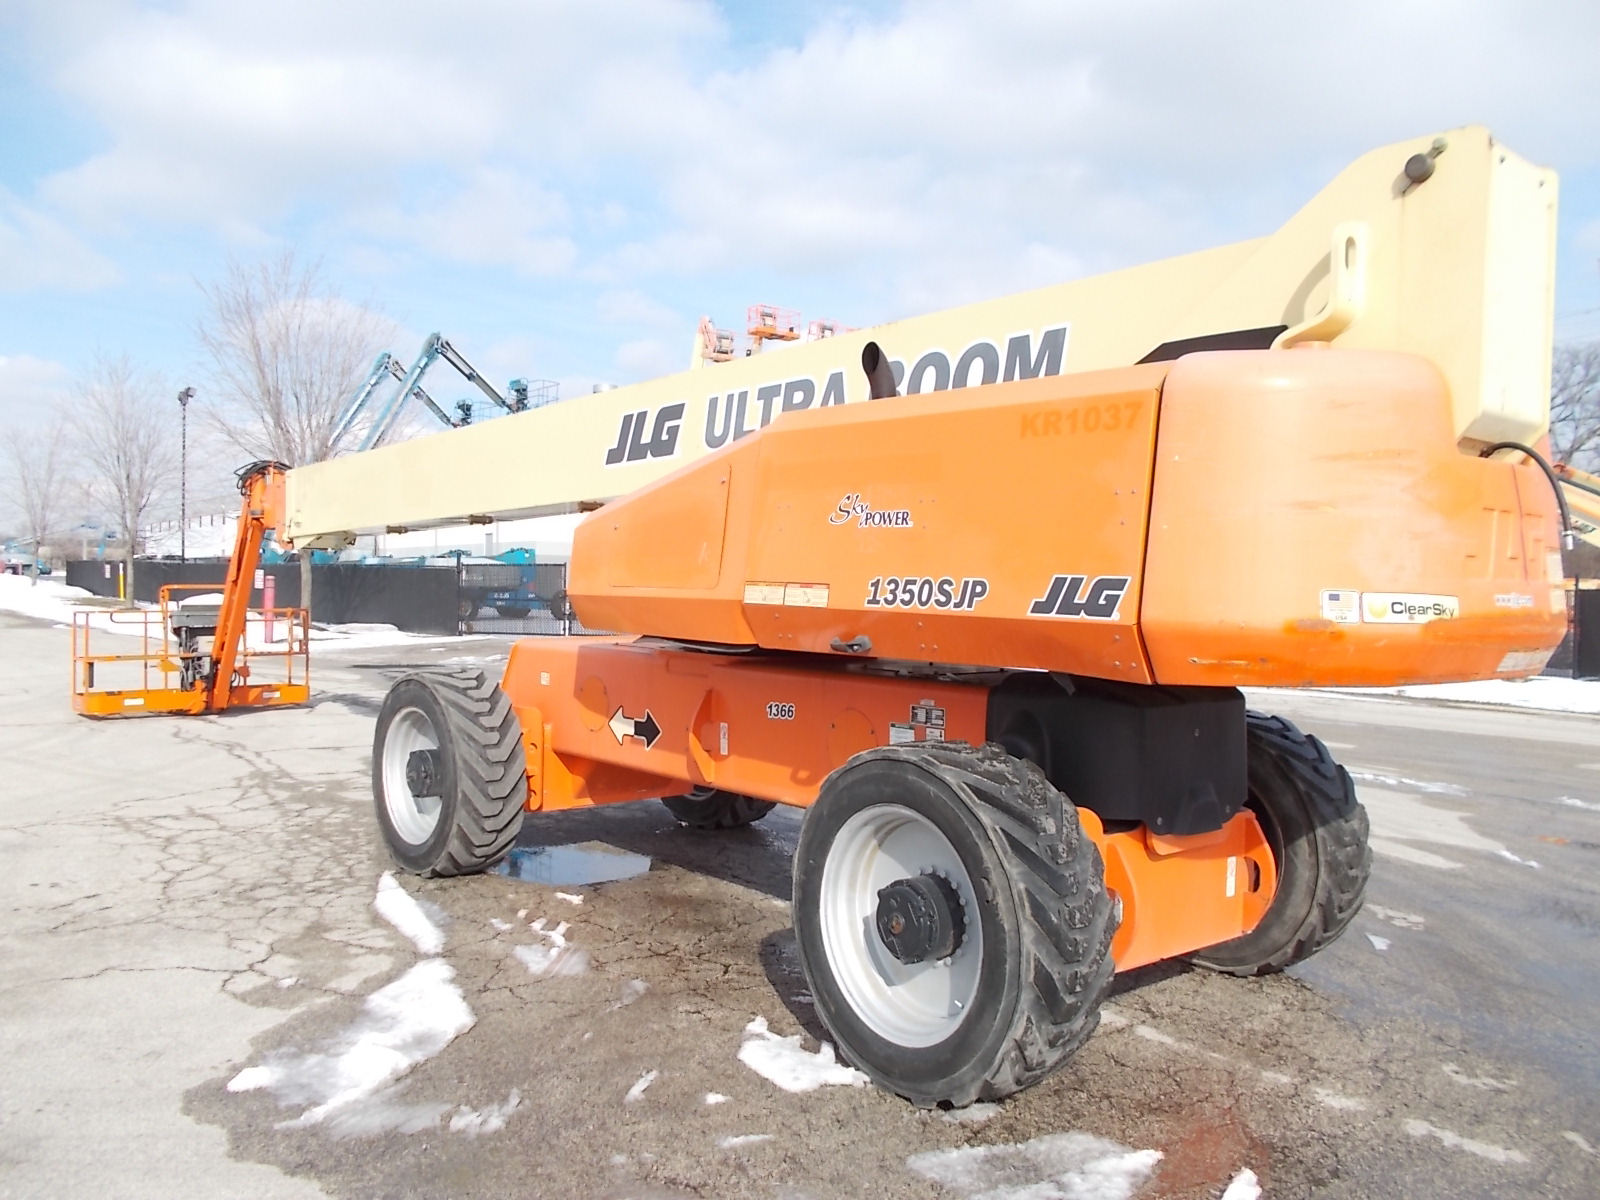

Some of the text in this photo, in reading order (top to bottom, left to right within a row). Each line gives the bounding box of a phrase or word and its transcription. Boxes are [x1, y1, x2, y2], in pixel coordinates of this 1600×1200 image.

[605, 402, 686, 466] JLG
[705, 371, 846, 449] ULTRA
[1019, 401, 1143, 438] KR1037
[829, 494, 909, 526] Sky POWER
[866, 577, 988, 609] 1350SJP
[1030, 576, 1129, 618] JLG
[1391, 601, 1455, 619] ClearSky
[767, 703, 794, 719] 1366
